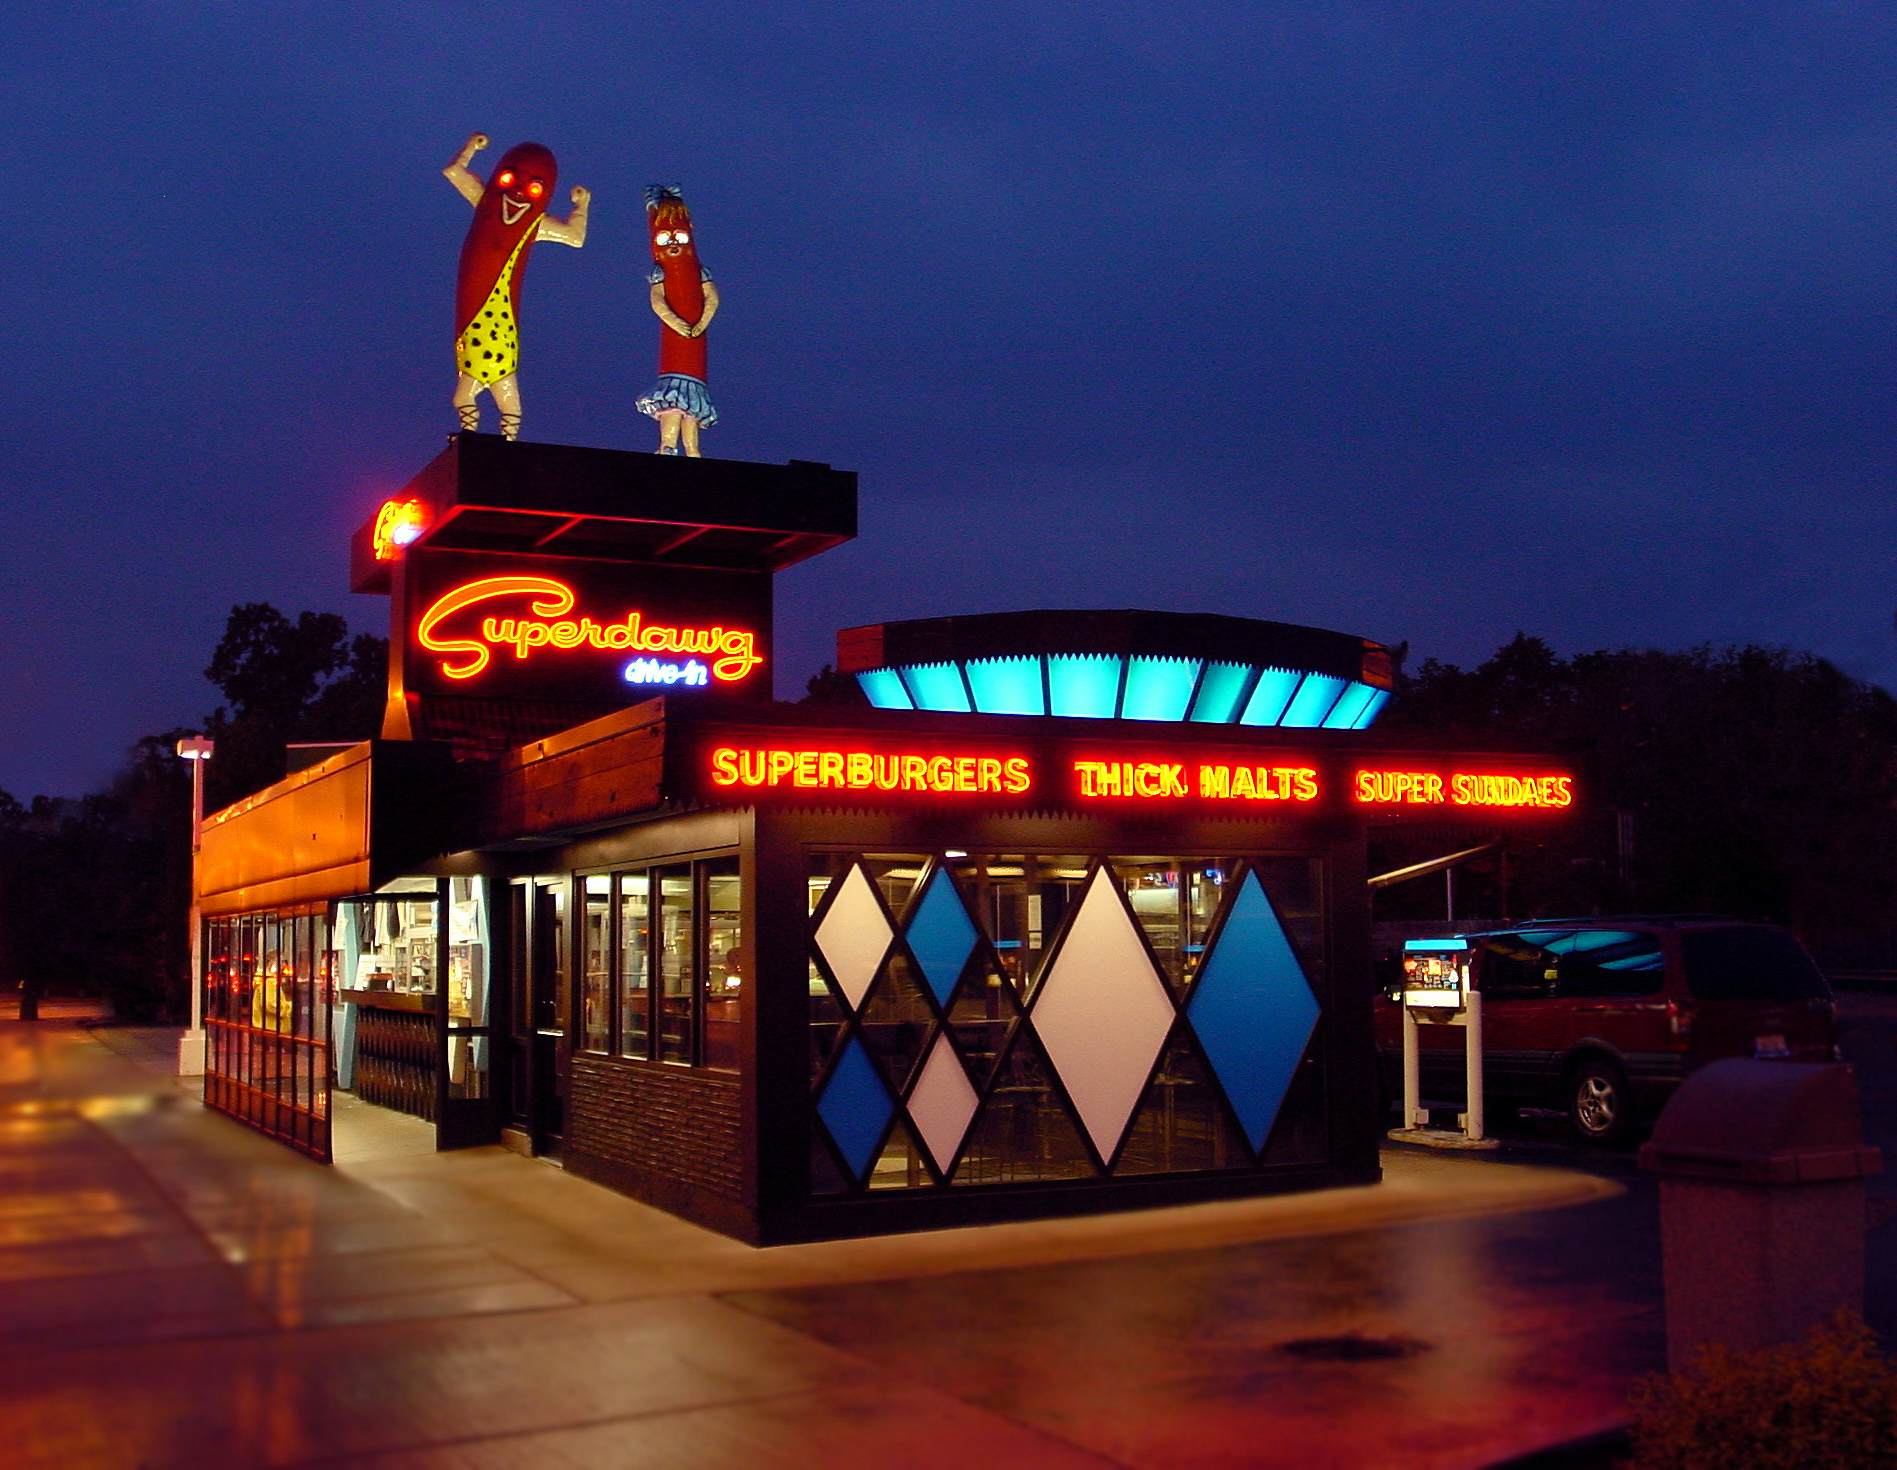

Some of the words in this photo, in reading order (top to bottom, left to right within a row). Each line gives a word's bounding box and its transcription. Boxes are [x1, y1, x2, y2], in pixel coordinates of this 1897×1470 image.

[418, 576, 763, 681] Superdawg
[711, 748, 1030, 793] SUPERBURGERS
[1074, 761, 1188, 797] THICK
[1199, 765, 1318, 800] MALTS
[1355, 769, 1445, 803] SUPER
[1451, 773, 1572, 807] SUNDAES
